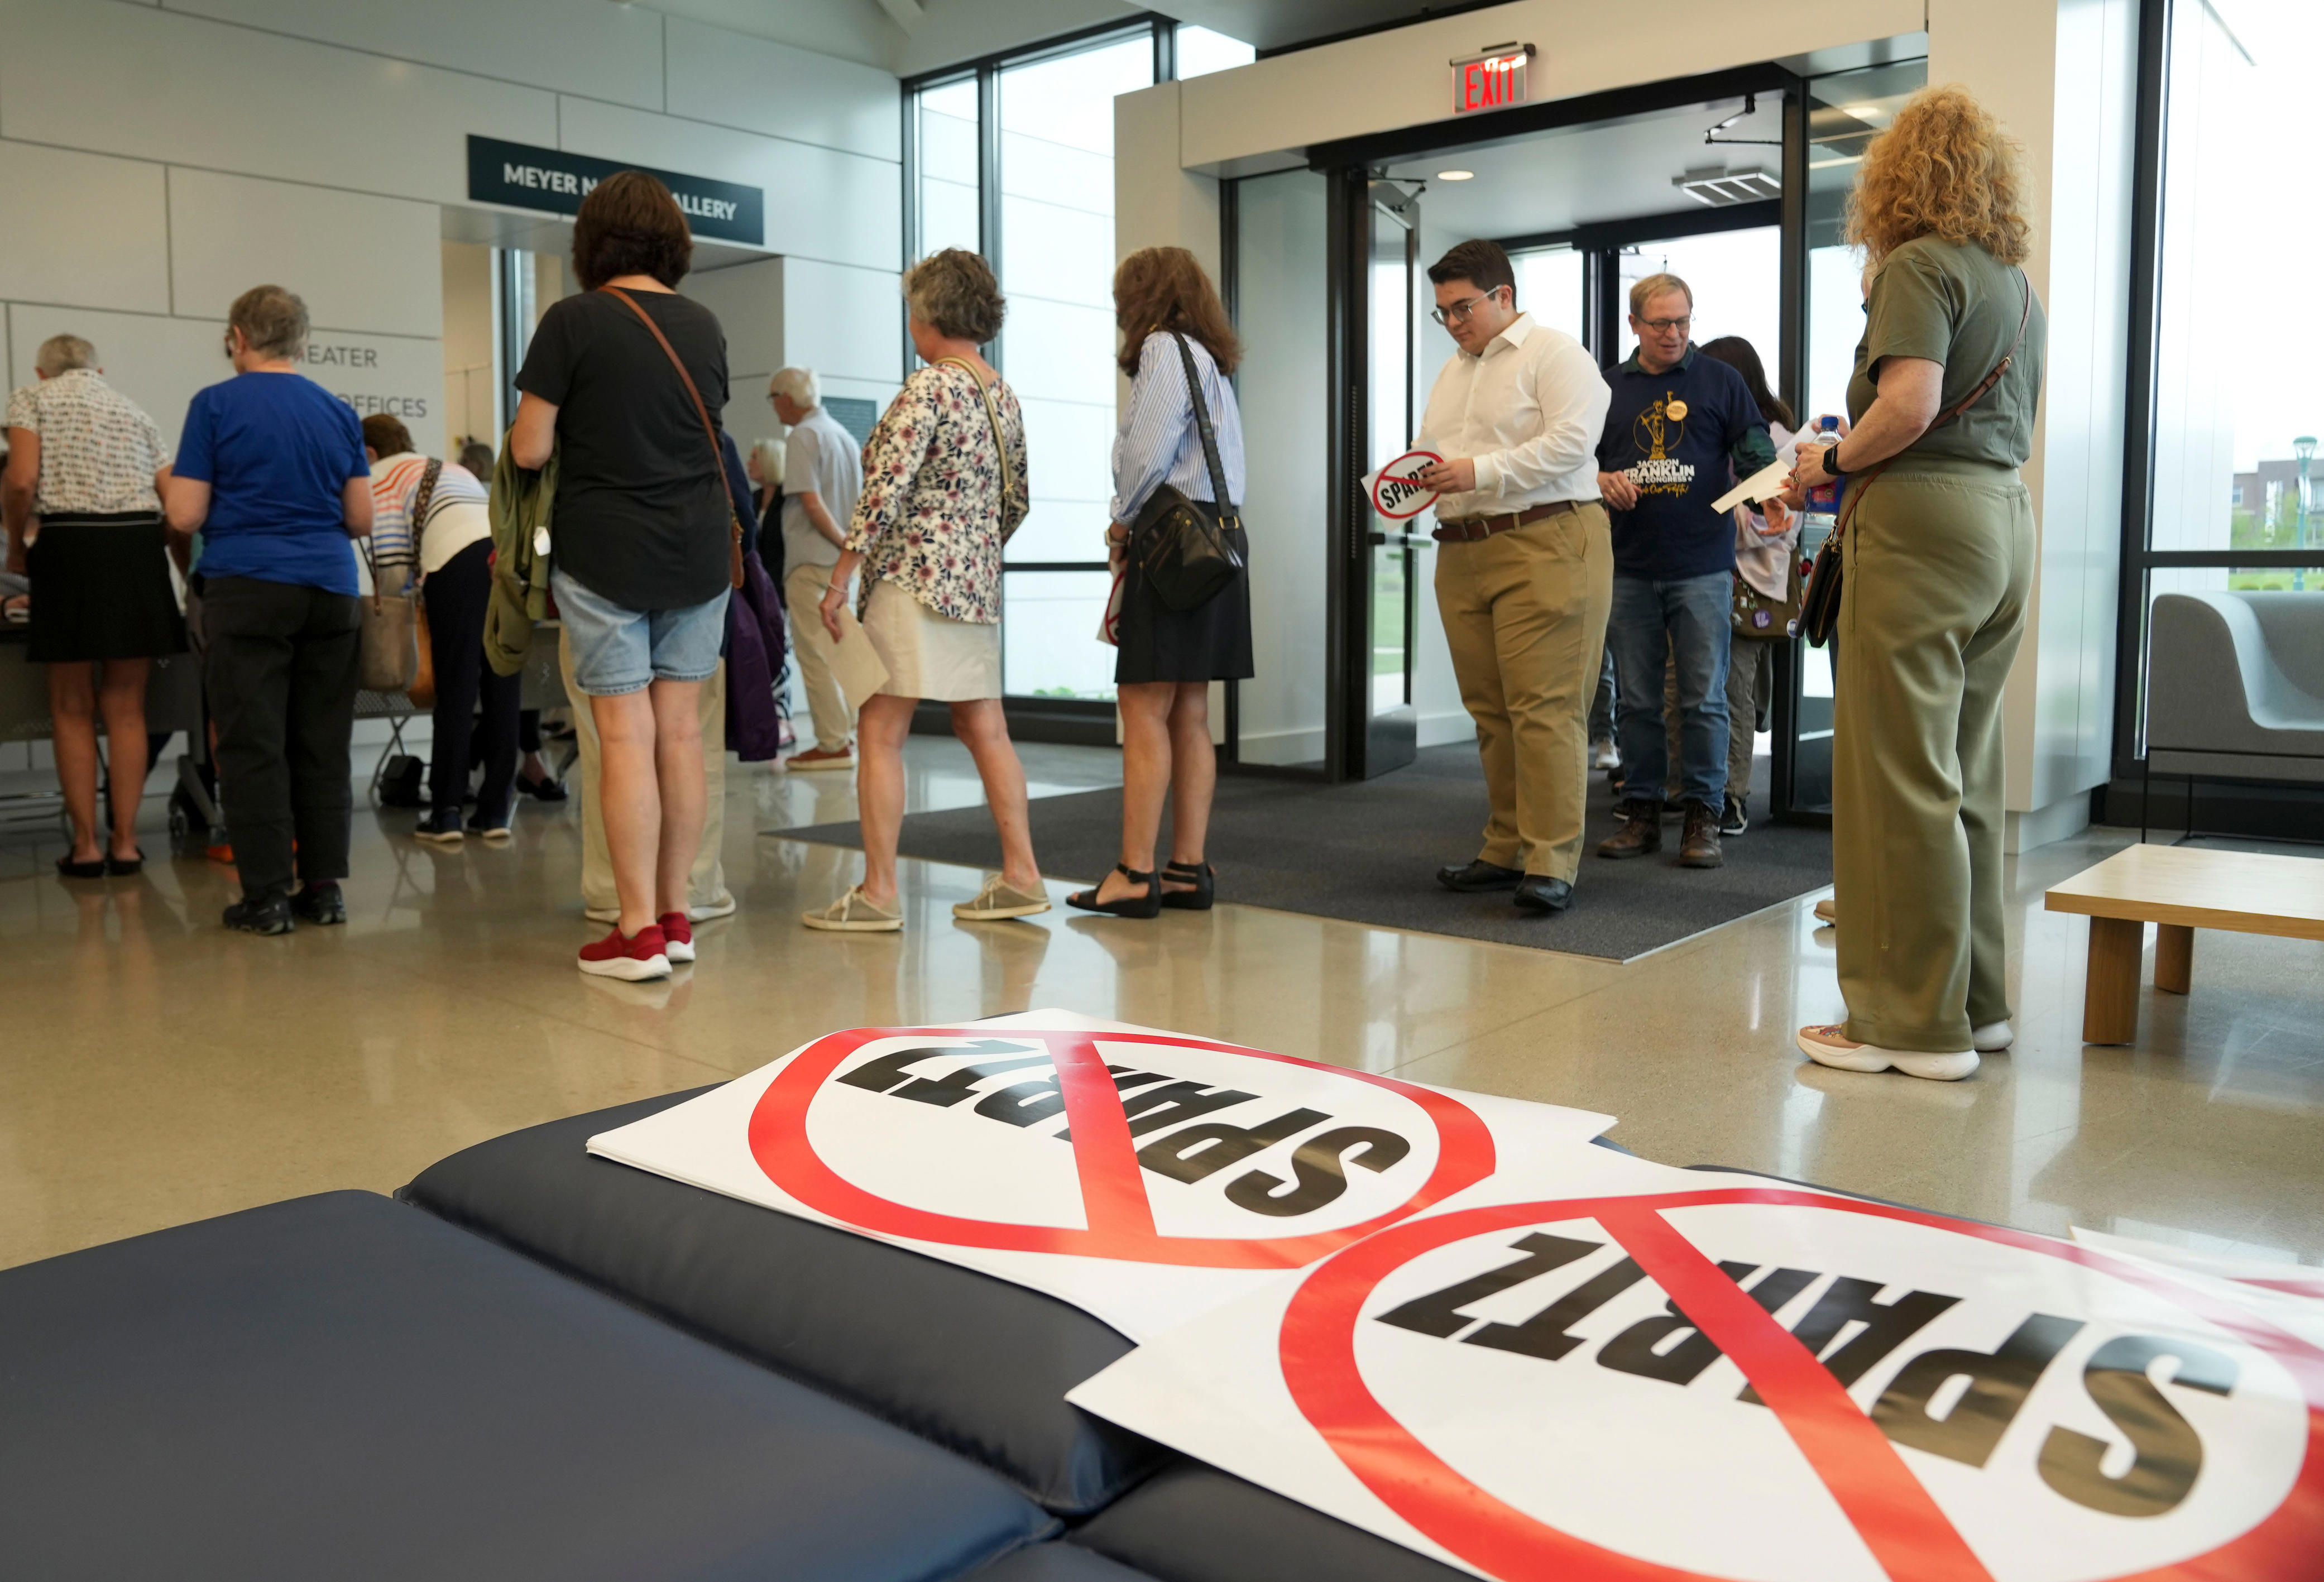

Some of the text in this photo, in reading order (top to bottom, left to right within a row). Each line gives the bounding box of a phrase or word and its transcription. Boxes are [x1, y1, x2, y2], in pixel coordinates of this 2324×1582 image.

[1465, 56, 1518, 111] EXIT
[504, 162, 578, 195] MEYER
[294, 344, 378, 368] EATER
[1623, 464, 1695, 480] FRANKLIN
[1636, 458, 1680, 469] JACKSON
[1645, 473, 1687, 484] CONGRESS
[835, 1039, 1411, 1217] SPARTZ
[1372, 1230, 2240, 1519] SPARTZ
